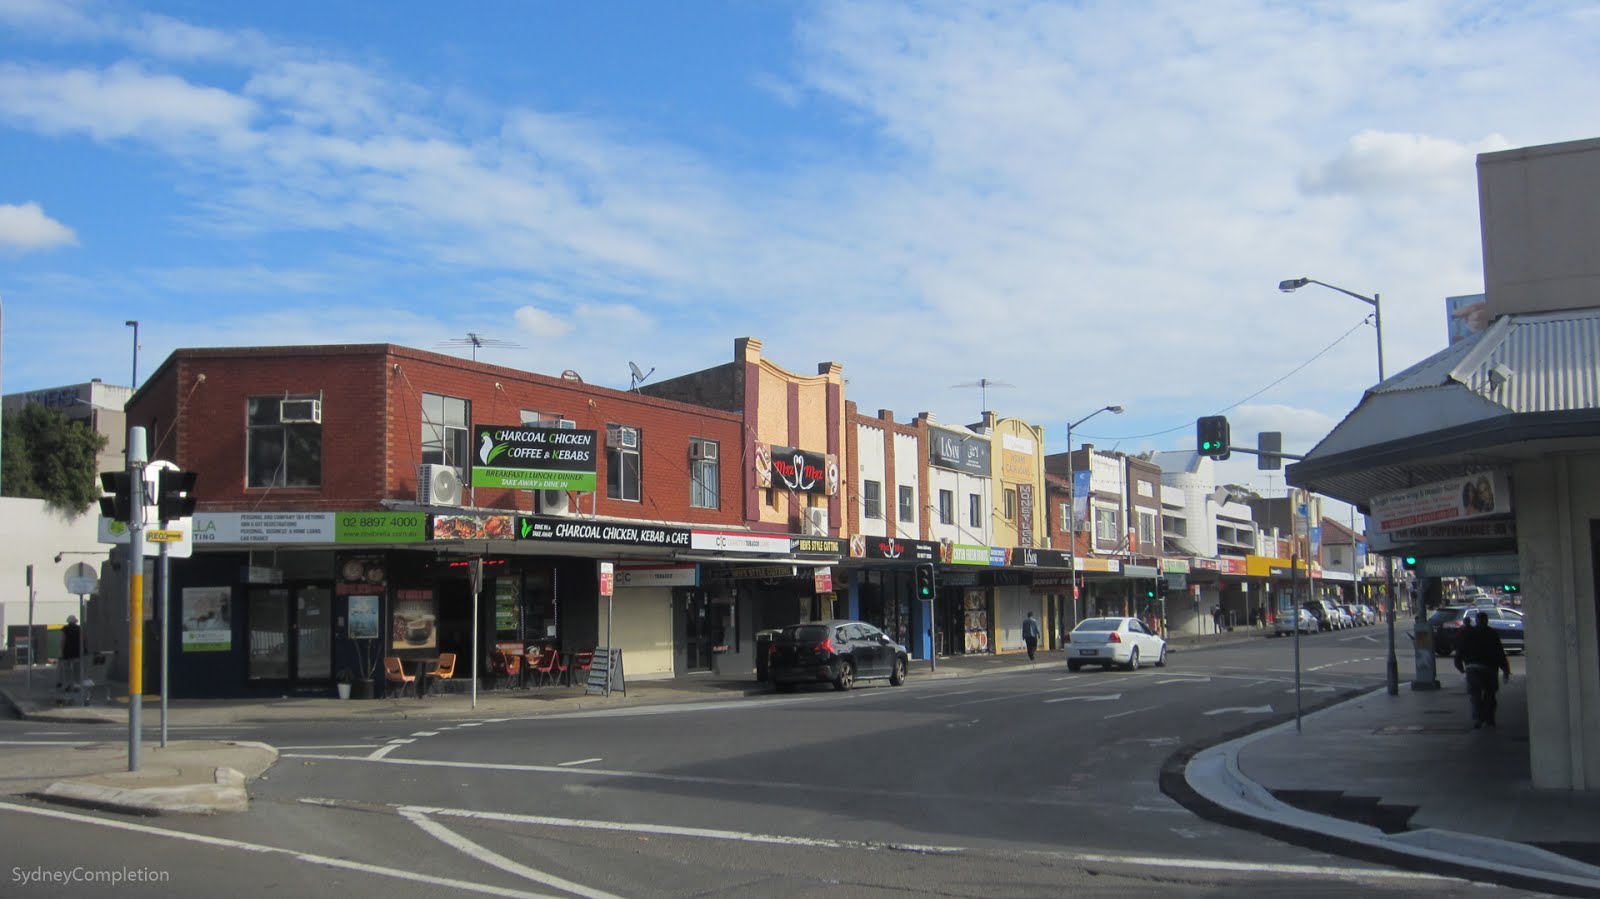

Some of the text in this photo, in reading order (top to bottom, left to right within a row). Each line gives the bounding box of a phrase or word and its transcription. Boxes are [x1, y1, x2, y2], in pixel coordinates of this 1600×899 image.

[494, 430, 591, 445] CHARCOAL CHICKEN
[507, 447, 590, 461] COFFEE & KEBABS
[485, 470, 524, 478] BREAKFAST
[557, 473, 584, 481] DINNER
[1020, 485, 1031, 521] MONEY
[343, 517, 417, 527] 02 8897 4000
[556, 523, 689, 545] CHARCOAL CHICKEN, KEBAB & CAFE
